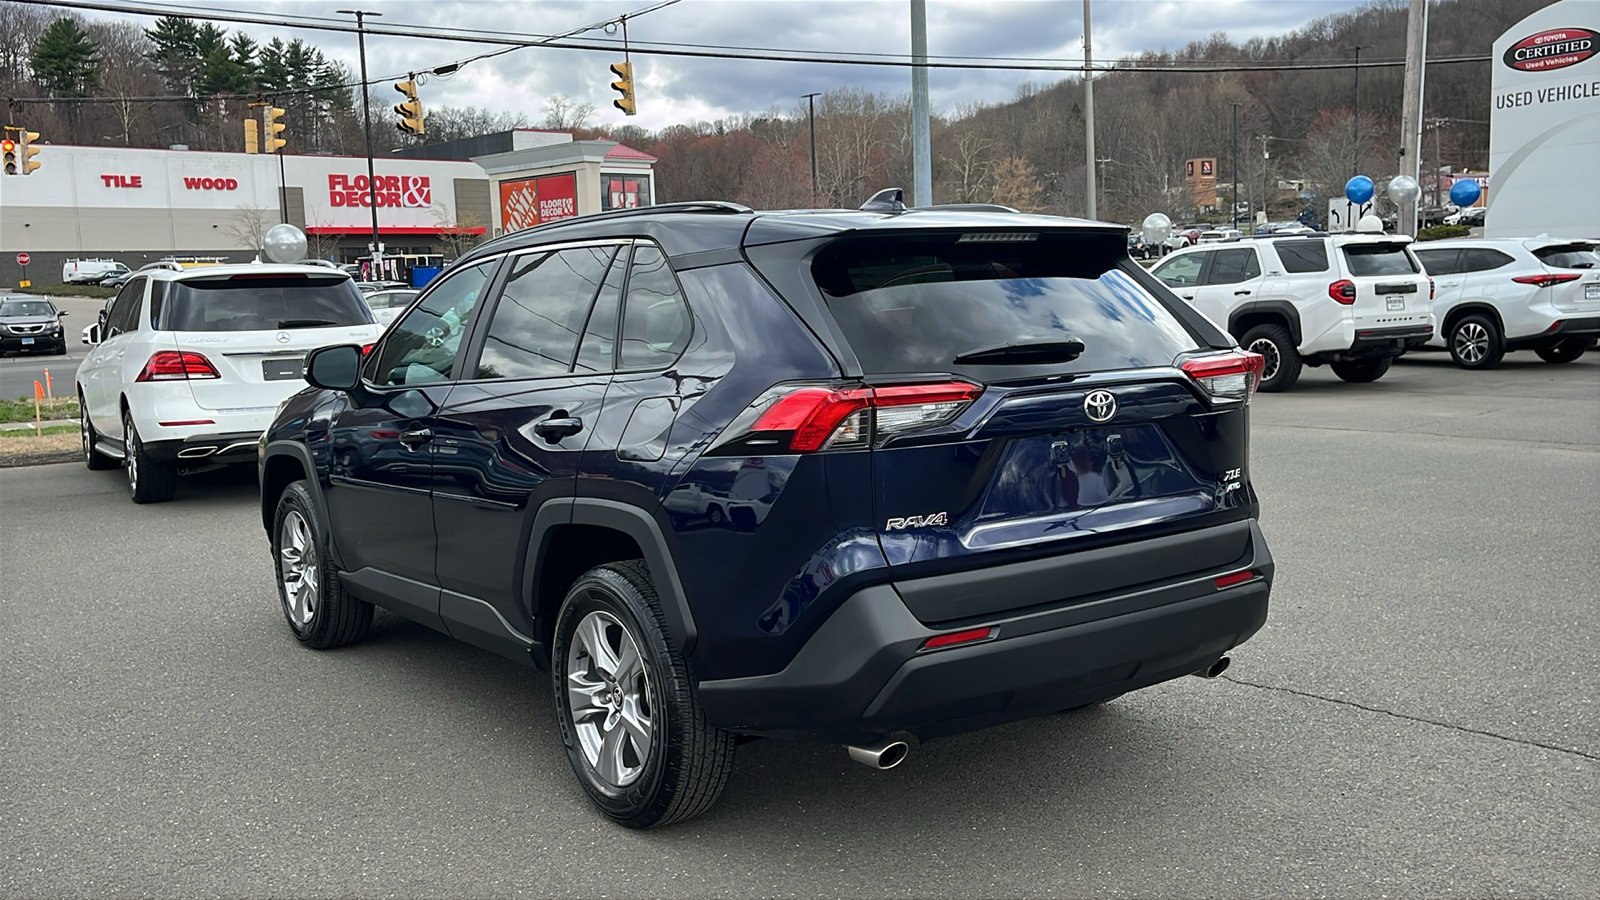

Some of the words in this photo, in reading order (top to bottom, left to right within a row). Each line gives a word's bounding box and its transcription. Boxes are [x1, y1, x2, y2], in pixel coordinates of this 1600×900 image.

[1543, 33, 1567, 42] TOYOTA
[1514, 40, 1592, 61] CERTIFIED
[1526, 60, 1544, 69] Used
[1545, 56, 1578, 66] Vehicles
[1496, 91, 1533, 110] USED
[1538, 82, 1600, 103] VEHICLE
[101, 175, 142, 188] TILE
[184, 177, 238, 190] WOOD
[328, 174, 401, 191] FLOOR
[401, 176, 432, 208] &
[329, 191, 402, 208] DECOR
[540, 199, 563, 209] FLOOR
[541, 208, 563, 217] DECOR
[885, 512, 949, 531] RAV4
